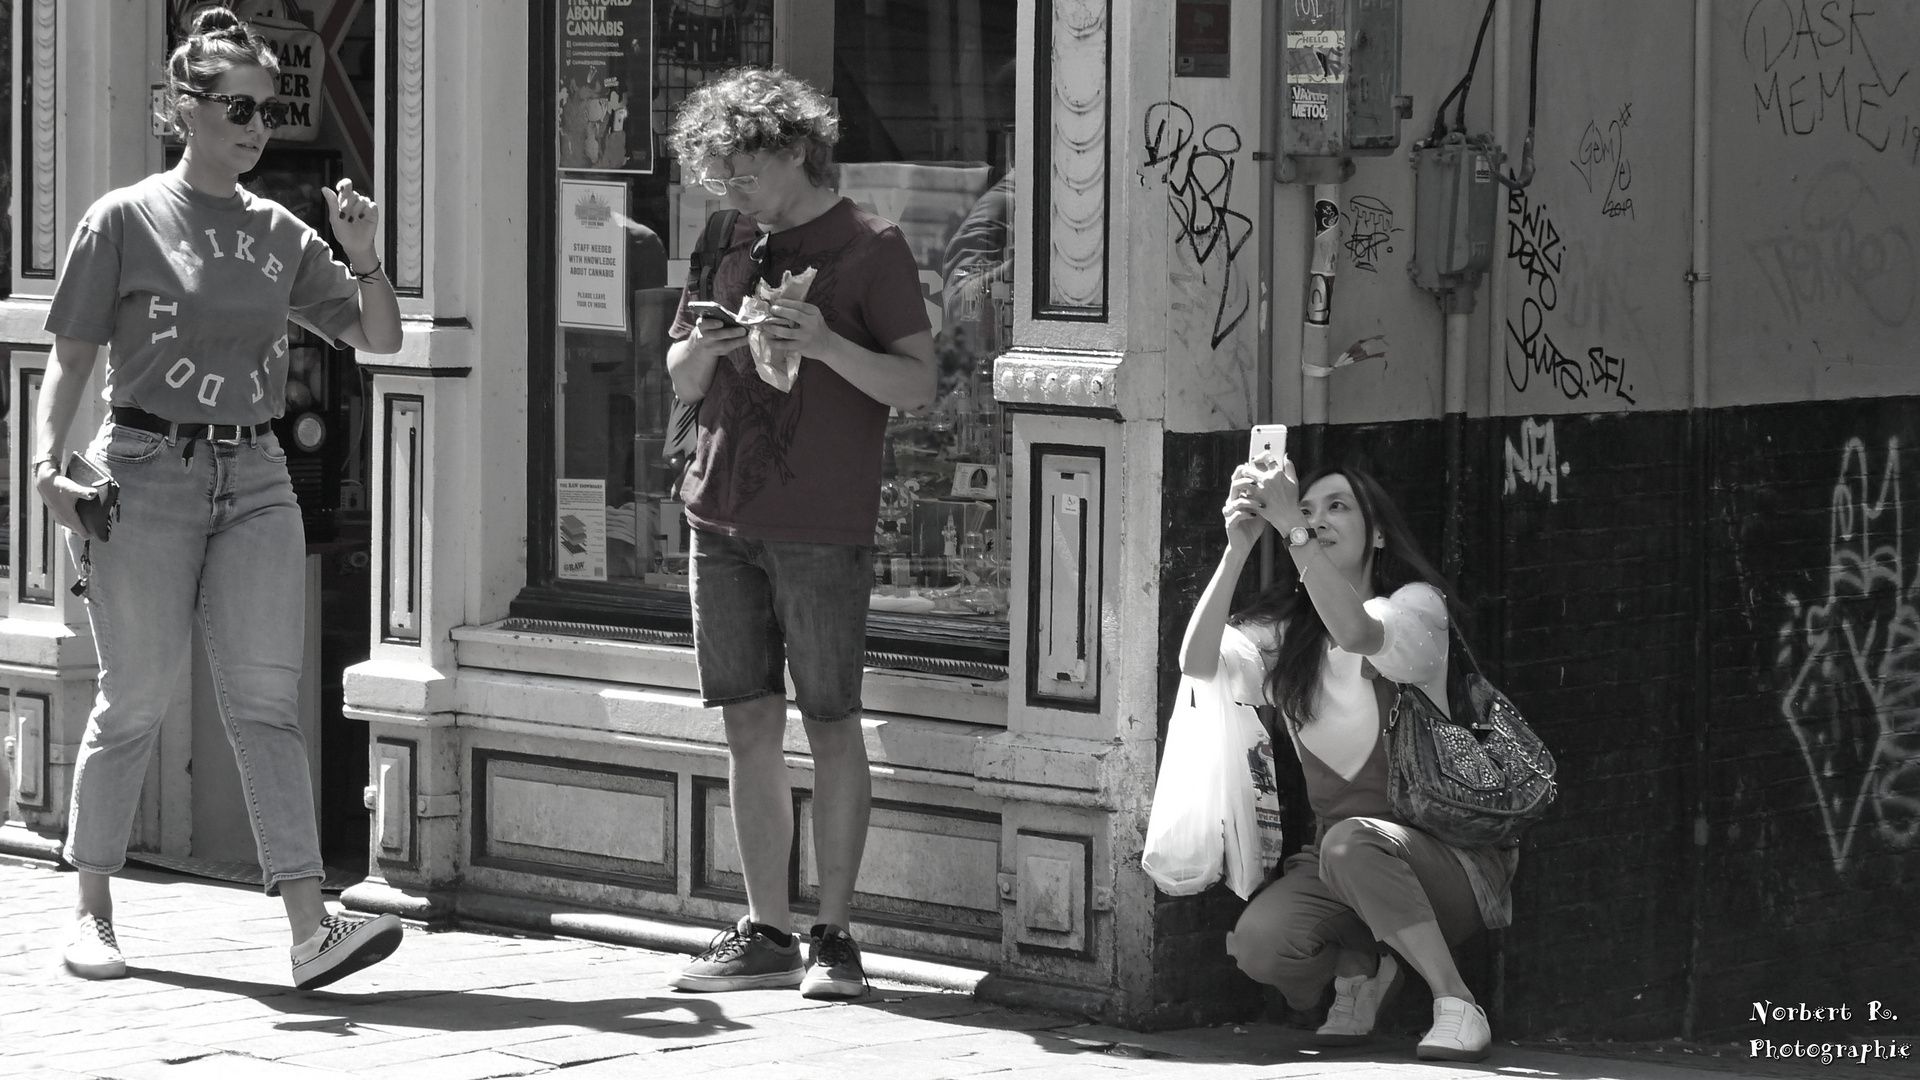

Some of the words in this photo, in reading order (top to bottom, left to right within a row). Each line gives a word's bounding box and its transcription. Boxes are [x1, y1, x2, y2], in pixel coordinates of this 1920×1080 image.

[566, 6, 607, 21] ABOUT
[566, 21, 624, 36] CANNABIS
[1302, 36, 1329, 44] HELLO
[573, 243, 590, 252] STAFF
[591, 244, 612, 254] NEEDED
[568, 255, 583, 264] WITH
[583, 256, 616, 266] KNOWLEDGE
[570, 267, 587, 276] ABOUT
[588, 268, 614, 278] CANNABIS
[577, 291, 592, 300] PLEASE
[593, 293, 606, 301] LEAVE
[576, 300, 587, 308] YOUR
[593, 302, 607, 310] INSIDE
